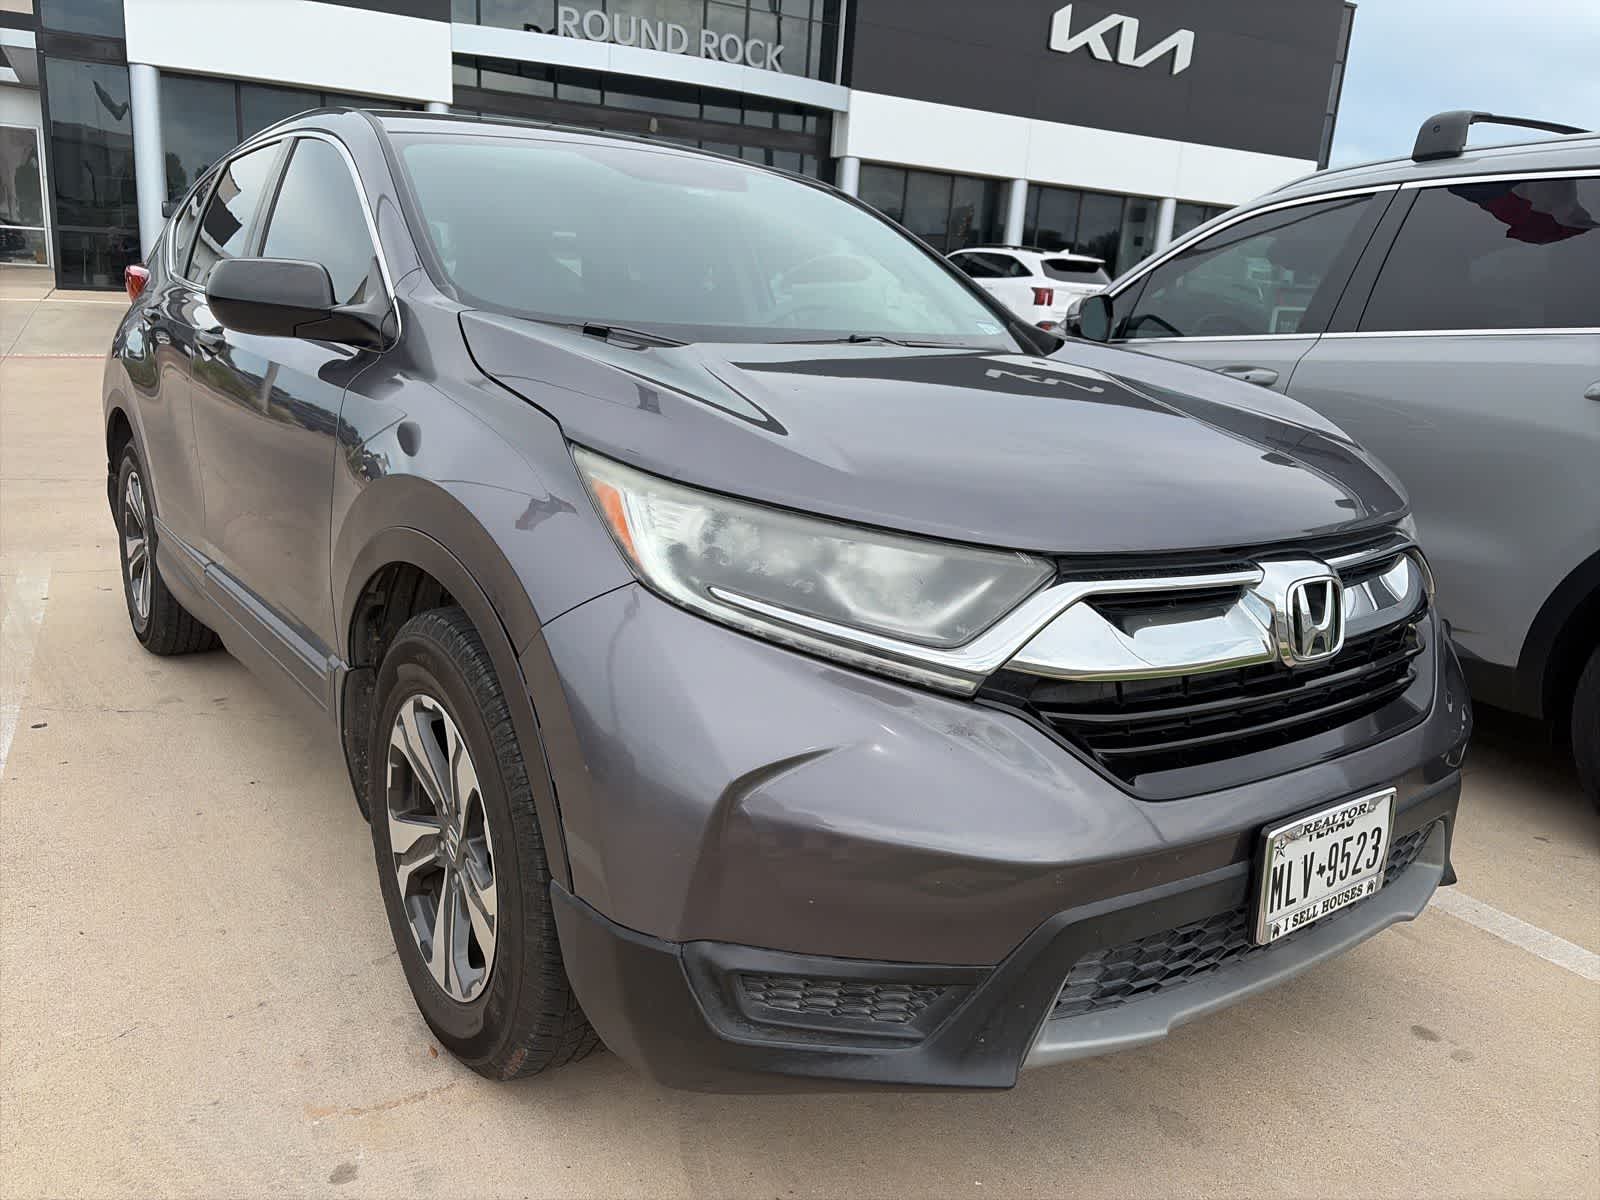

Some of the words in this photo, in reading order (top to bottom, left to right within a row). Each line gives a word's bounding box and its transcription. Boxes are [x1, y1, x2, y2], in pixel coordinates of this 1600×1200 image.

[557, 6, 688, 54] ROUND
[700, 29, 784, 73] ROCK
[1303, 803, 1367, 836] REALTOR
[1326, 826, 1383, 888] 9523
[1284, 917, 1290, 933] I
[1292, 905, 1318, 928] SELL
[1321, 884, 1364, 914] HOUSES
